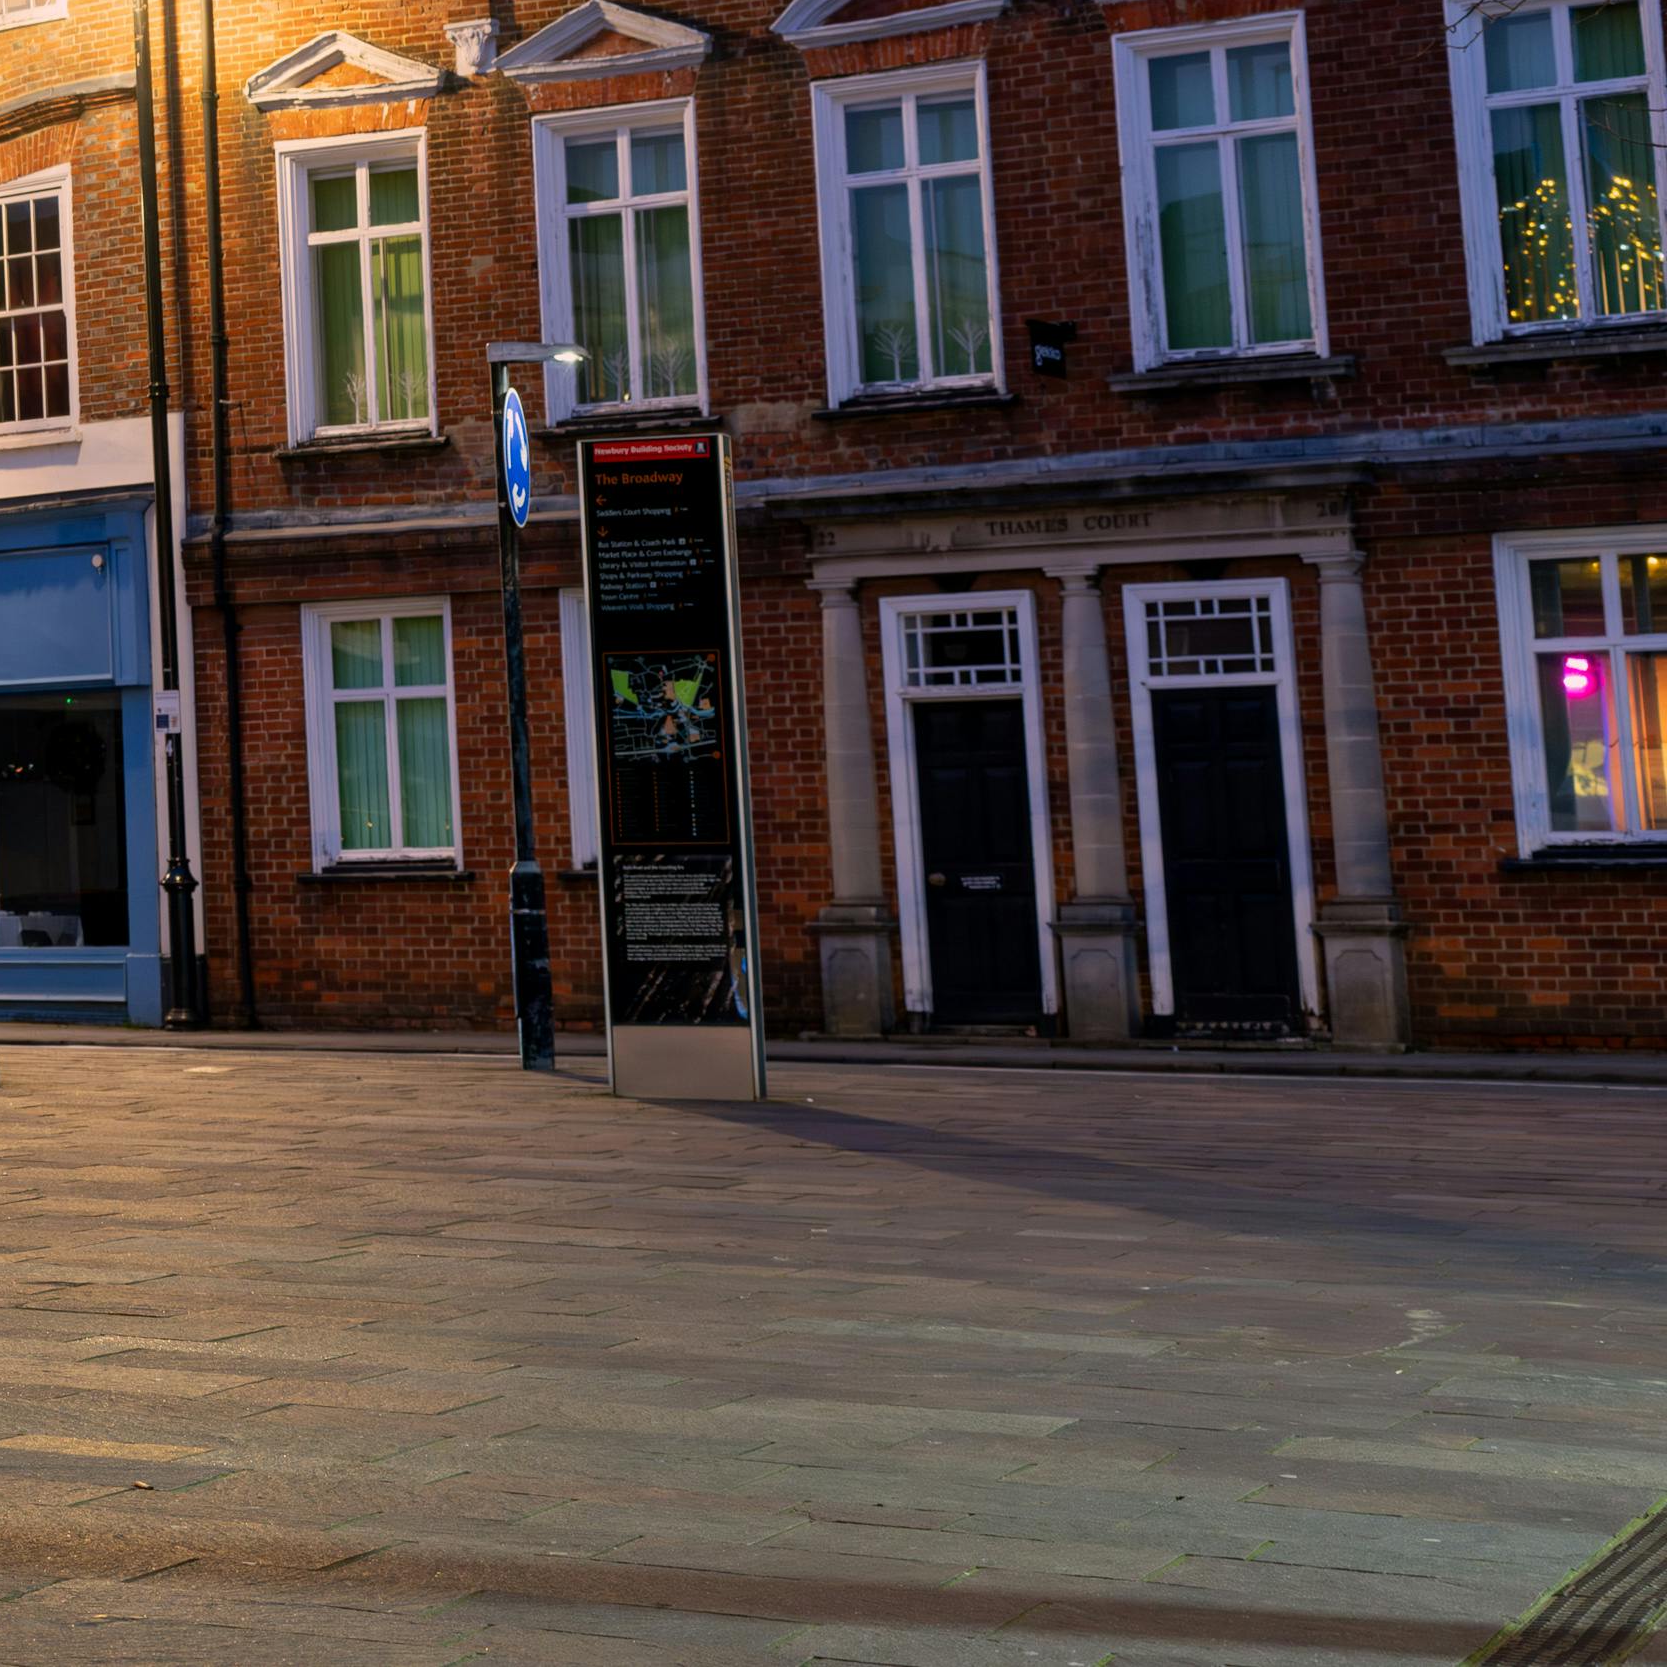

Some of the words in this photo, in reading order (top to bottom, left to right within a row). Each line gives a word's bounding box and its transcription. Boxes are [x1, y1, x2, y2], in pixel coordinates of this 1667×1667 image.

[594, 447, 629, 455] Newbury
[630, 444, 663, 454] Building
[664, 443, 693, 453] Society
[595, 474, 618, 485] The
[622, 471, 683, 485] Broadway
[985, 517, 1069, 536] THAMES
[1083, 513, 1153, 531] COURT
